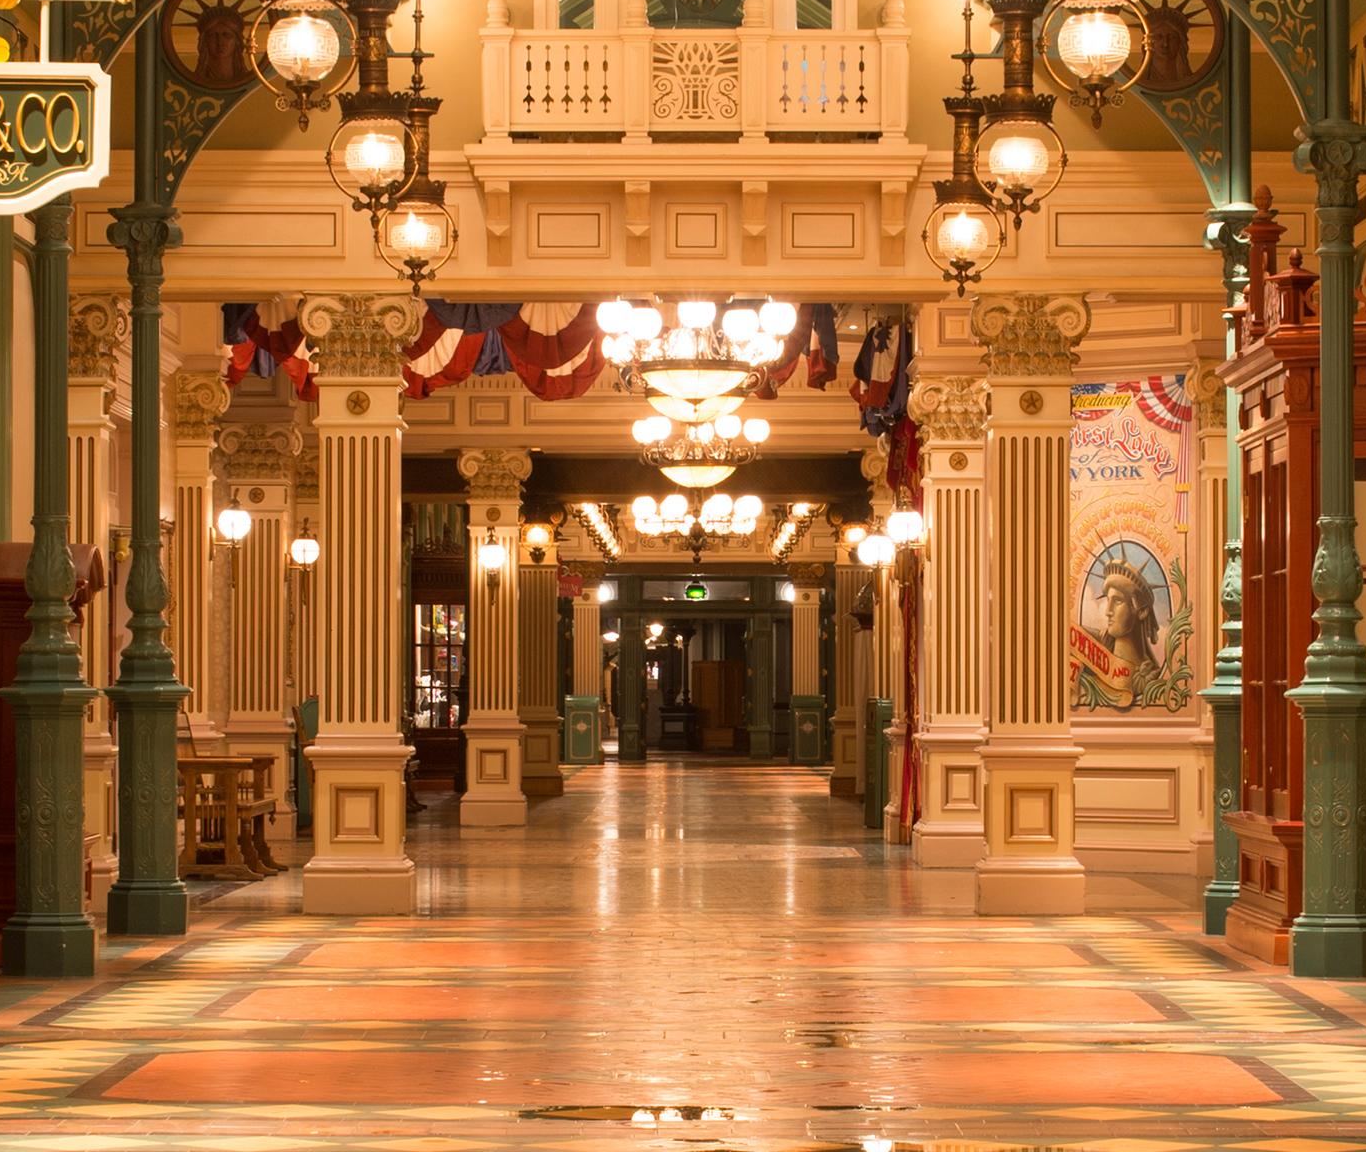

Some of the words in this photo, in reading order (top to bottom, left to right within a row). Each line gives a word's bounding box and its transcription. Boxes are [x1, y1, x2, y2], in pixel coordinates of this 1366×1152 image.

[1113, 416, 1177, 480] Lady
[1086, 464, 1144, 482] YORK
[1111, 667, 1131, 680] AND
